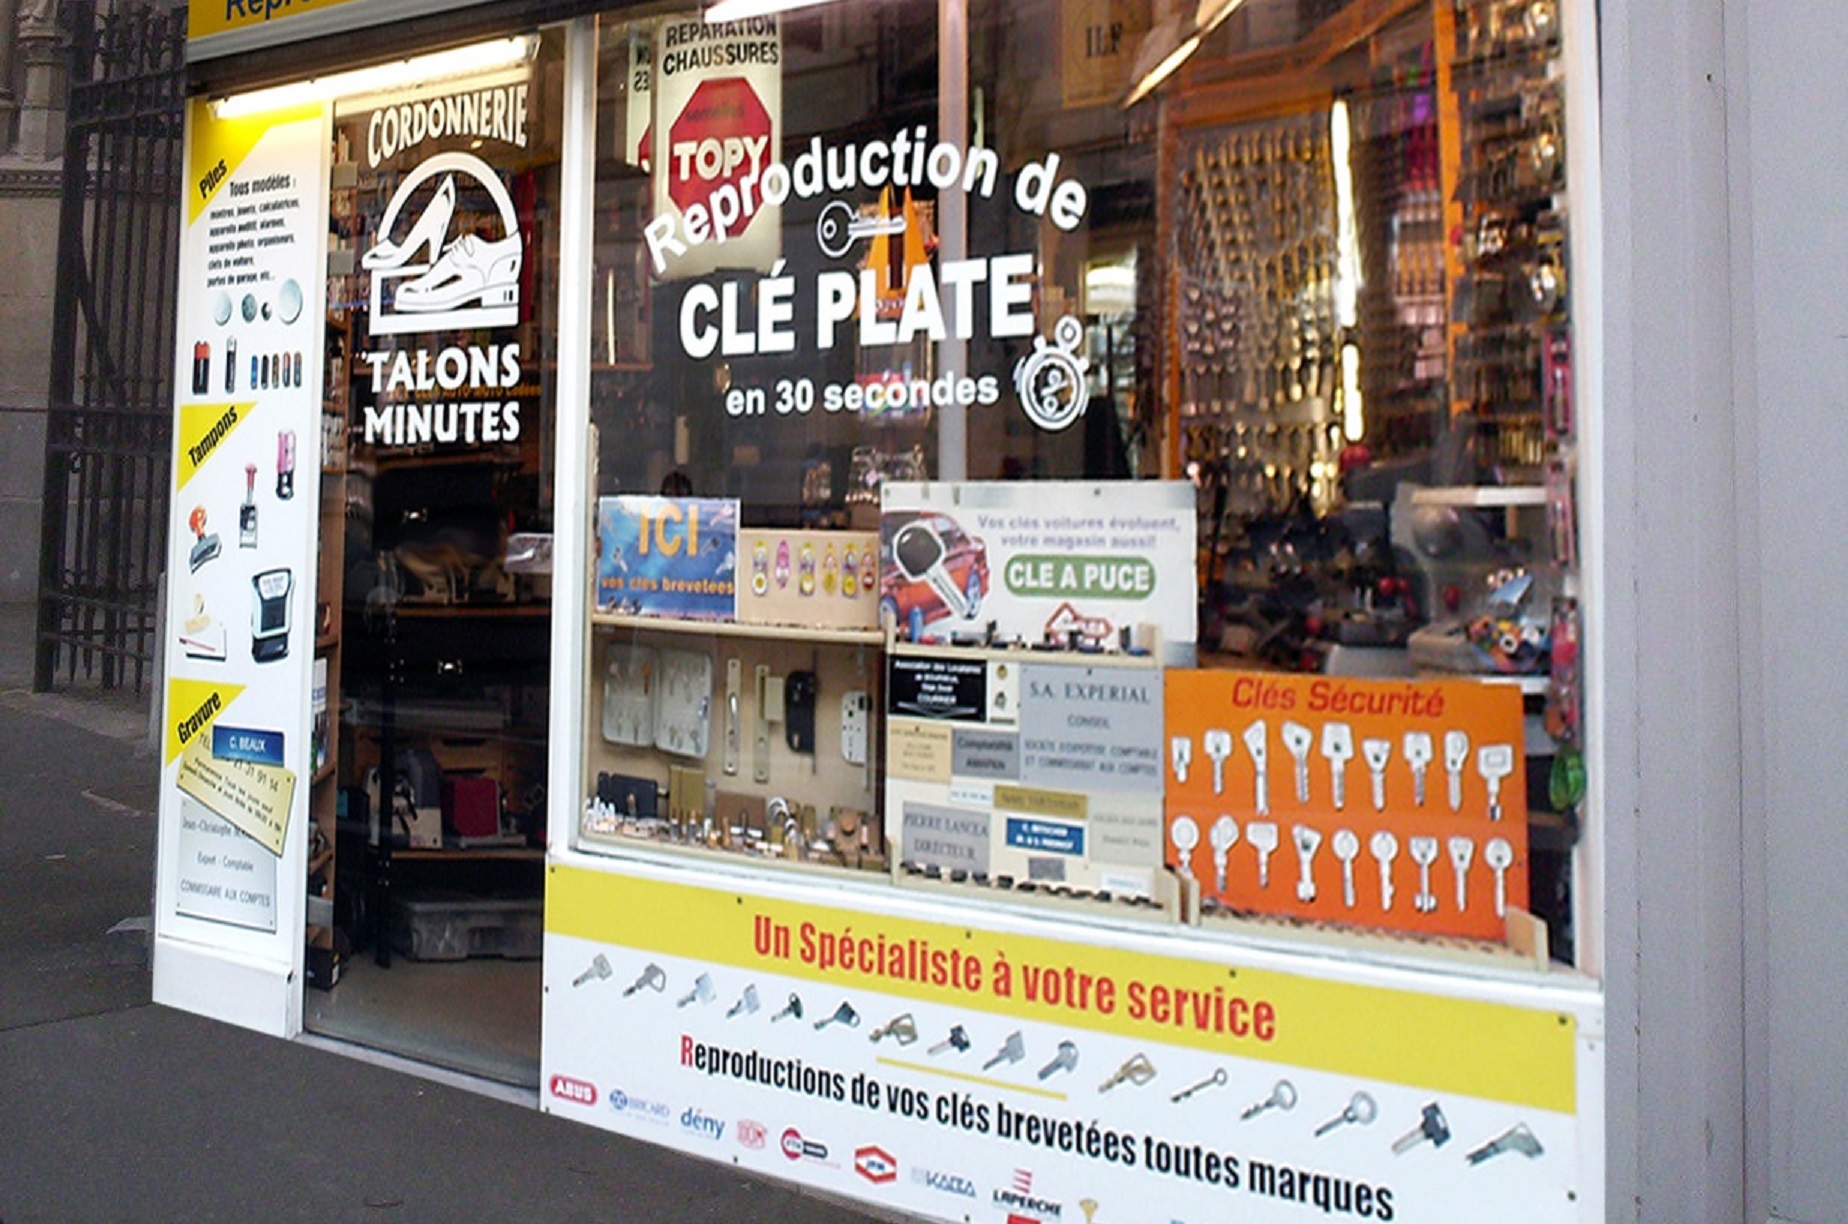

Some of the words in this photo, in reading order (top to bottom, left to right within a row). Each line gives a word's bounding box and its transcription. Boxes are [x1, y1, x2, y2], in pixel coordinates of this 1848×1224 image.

[662, 41, 780, 76] CHAUSSURES
[367, 83, 529, 169] CORDONNERIE
[199, 159, 227, 199] Piles
[673, 135, 769, 182] TOPY
[229, 180, 250, 198] Tous
[643, 125, 998, 274] Reproduction
[1014, 153, 1088, 231] de
[679, 259, 796, 359] CLÉ
[816, 253, 1035, 349] PLATE
[364, 344, 521, 394] TALONS
[725, 386, 765, 416] en
[775, 377, 814, 415] 30
[823, 371, 998, 412] secondes
[187, 405, 238, 468] Tampons
[362, 401, 520, 446] MINUTES
[638, 503, 698, 556] ICI
[1001, 534, 1039, 547] votre
[1043, 535, 1107, 551] magasin
[1043, 514, 1105, 531] voitures
[601, 576, 624, 589] vos
[1009, 562, 1054, 589] CLE
[1060, 565, 1078, 589] A
[1084, 564, 1150, 592] PUCE
[177, 691, 222, 745] Gravure
[1231, 676, 1297, 710] Clés
[1308, 679, 1446, 717] Sécurité
[753, 914, 790, 957] Un
[799, 920, 982, 992] Spécialiste
[992, 950, 1014, 996] à
[1022, 964, 1116, 1016] votre
[1127, 978, 1277, 1042] service
[554, 1078, 593, 1102] ABUS
[680, 1107, 726, 1140] dény
[680, 1033, 846, 1103] Reproductions
[851, 1072, 881, 1107] de
[886, 1083, 930, 1122] vos
[935, 1091, 991, 1134] clés
[997, 1102, 1136, 1167] brevetées
[1144, 1135, 1241, 1189] toutes
[1248, 1159, 1394, 1222] marques
